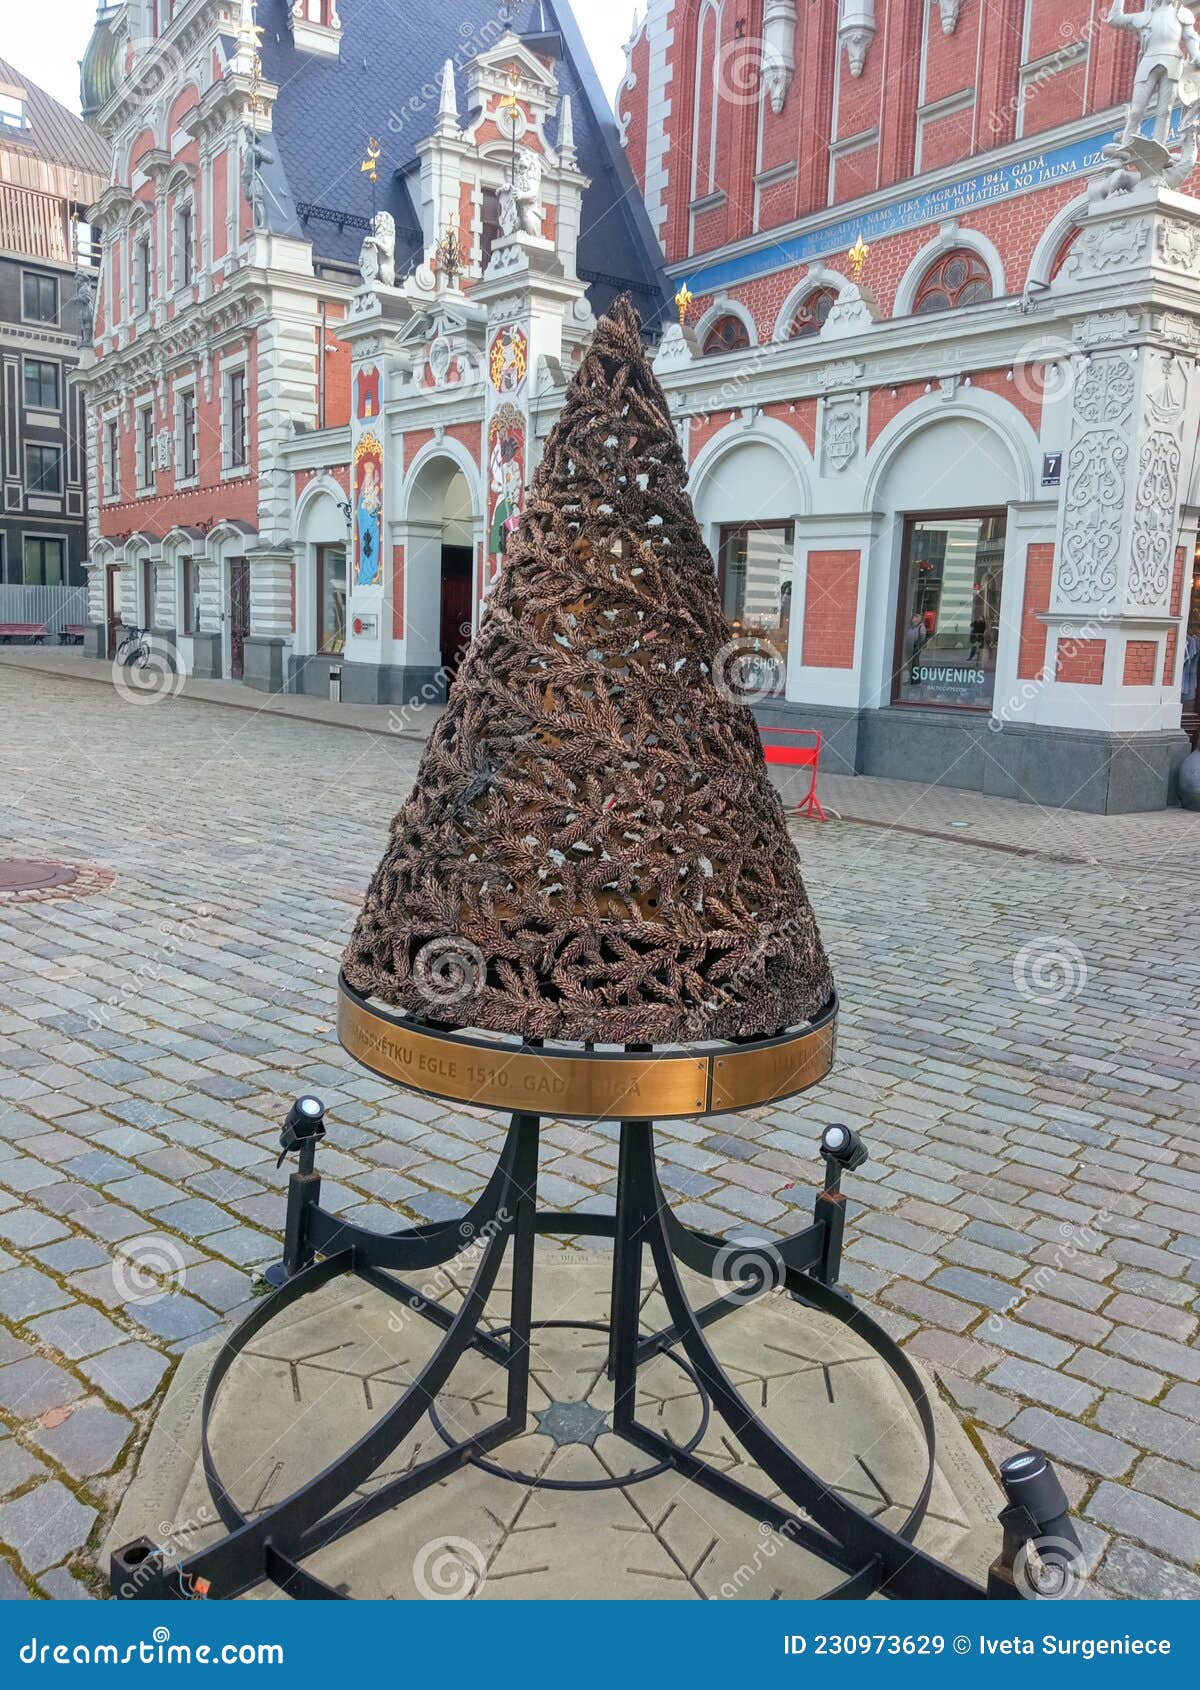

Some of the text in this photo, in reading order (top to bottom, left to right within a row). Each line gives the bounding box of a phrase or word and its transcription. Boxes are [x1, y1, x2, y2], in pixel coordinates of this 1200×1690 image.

[954, 184, 1009, 209] PAMATIEM
[1014, 174, 1033, 190] NO
[1038, 160, 1077, 182] JAUNA
[1083, 151, 1109, 168] UZC
[867, 210, 893, 225] NAMS
[897, 199, 920, 214] TIKA
[925, 179, 977, 206] SAGRAUTS
[982, 171, 1007, 187] 1941.
[1048, 459, 1056, 473] 7
[911, 666, 985, 684] SOUVENIRS
[419, 1054, 457, 1078] EGLE
[467, 1066, 513, 1089] 1510.
